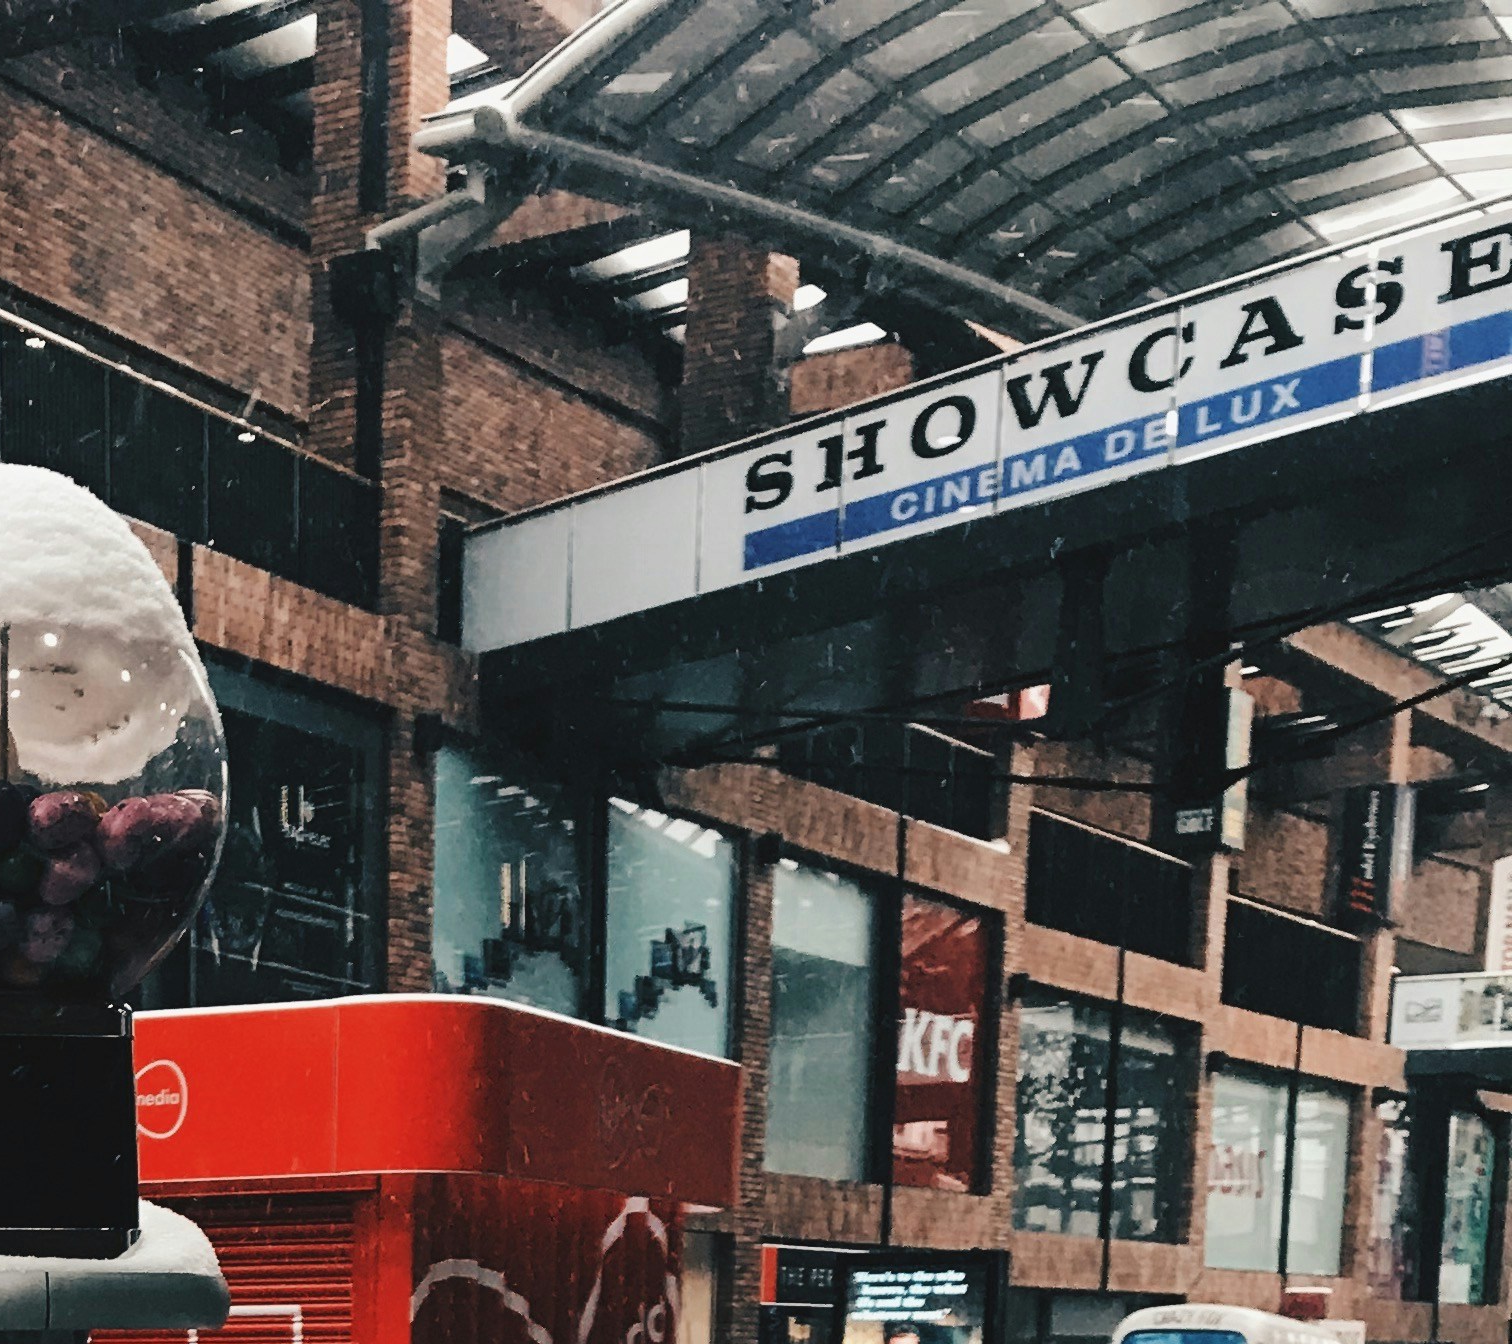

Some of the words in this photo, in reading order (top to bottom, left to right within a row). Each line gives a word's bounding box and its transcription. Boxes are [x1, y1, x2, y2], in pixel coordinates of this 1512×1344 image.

[744, 221, 1512, 513] SHOWCASE
[891, 450, 1082, 522] CINEMA
[1104, 416, 1171, 463] DE
[1196, 377, 1302, 436] LUX
[895, 1007, 975, 1083] KFC
